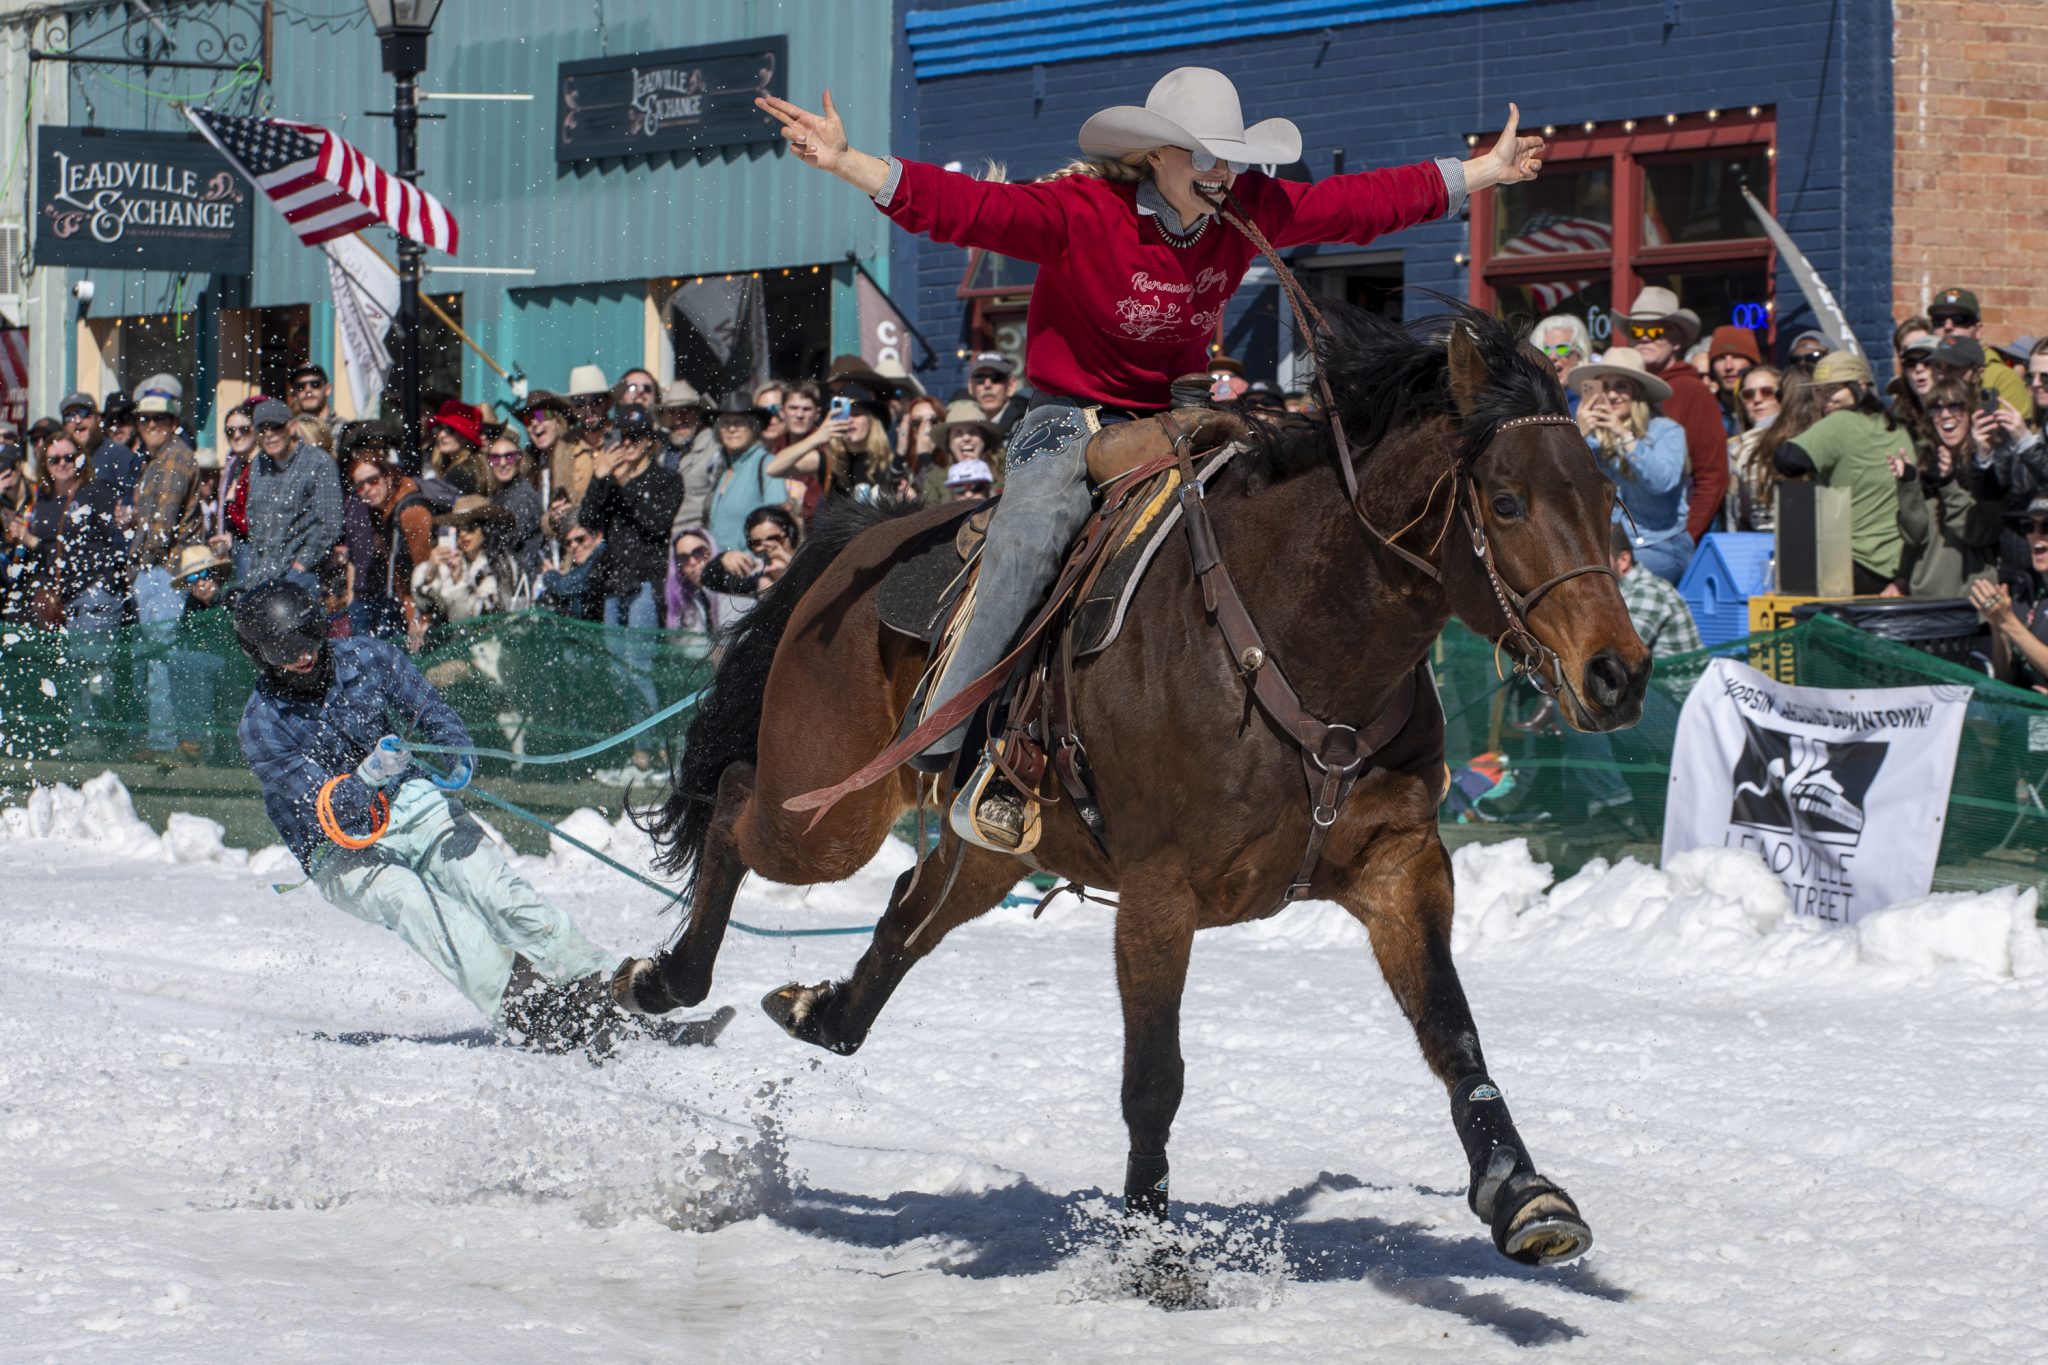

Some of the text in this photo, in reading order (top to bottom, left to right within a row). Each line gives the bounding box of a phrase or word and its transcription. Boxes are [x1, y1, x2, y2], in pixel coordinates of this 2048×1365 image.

[631, 67, 688, 111] LEADVILLE
[644, 94, 702, 136] EXCHANGE
[53, 151, 199, 210] LEADVILLE
[90, 190, 236, 243] EXCHANGE
[1131, 271, 1196, 303] Runaway
[1828, 704, 1934, 732] DOWNTOWN!
[1782, 881, 1854, 923] TREET
